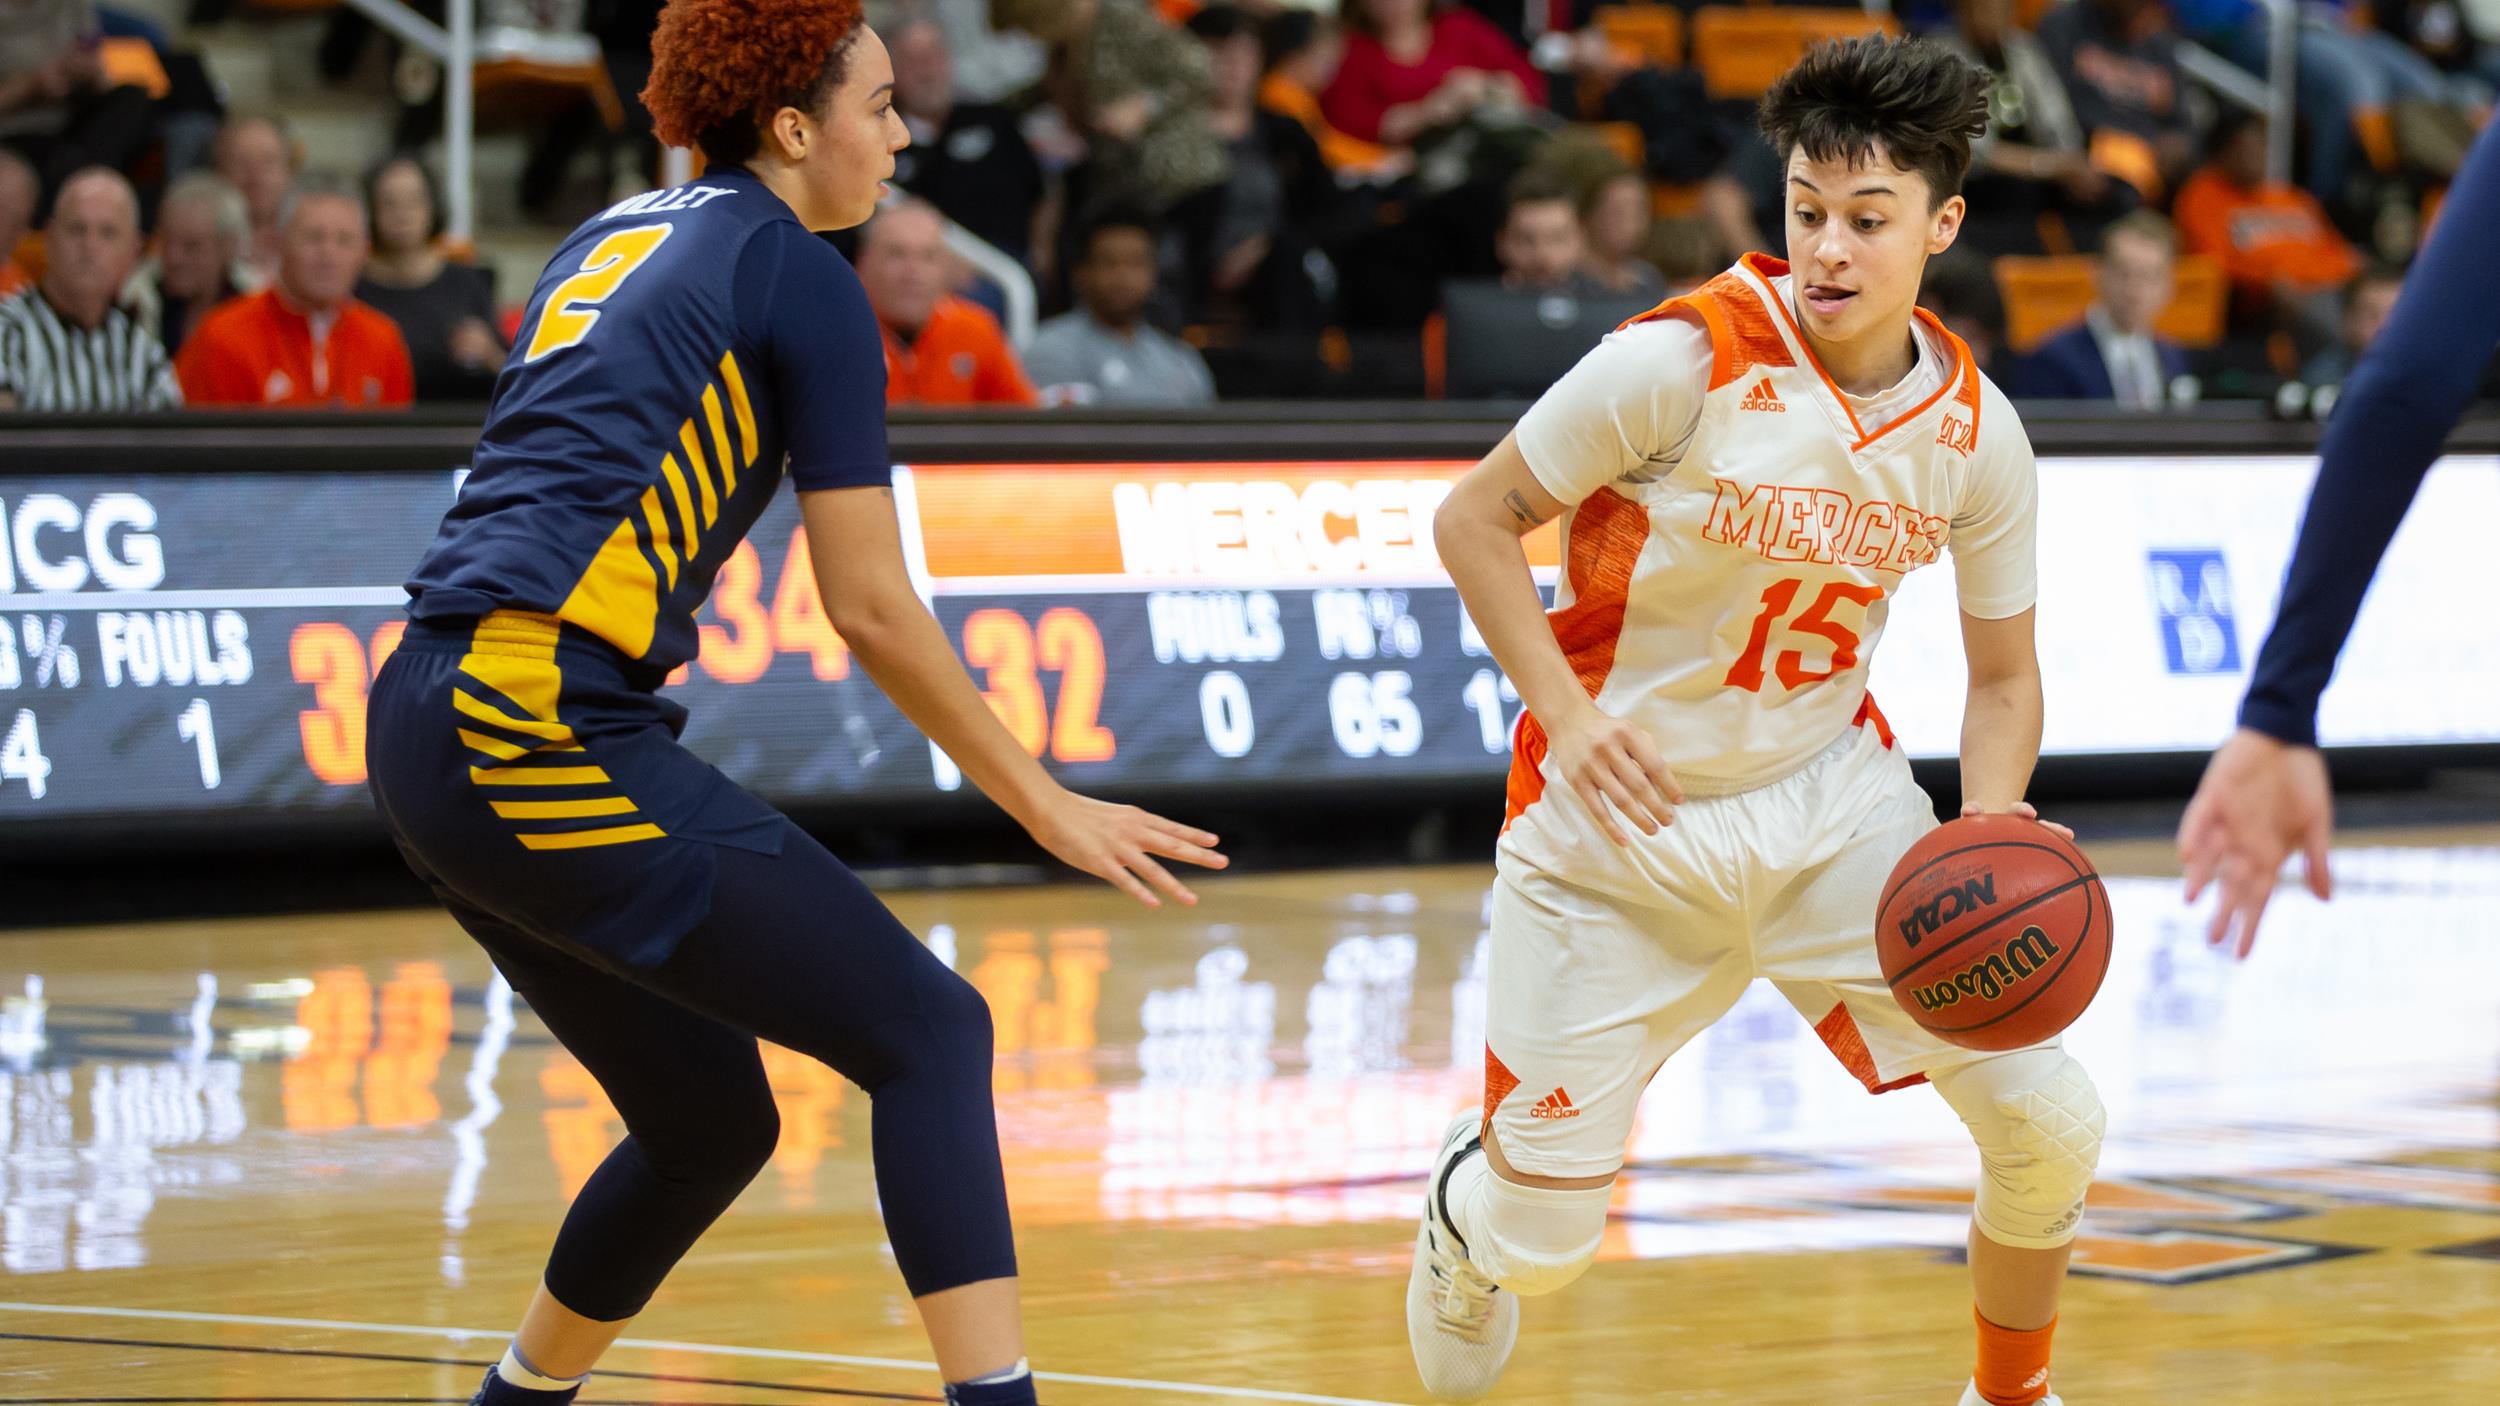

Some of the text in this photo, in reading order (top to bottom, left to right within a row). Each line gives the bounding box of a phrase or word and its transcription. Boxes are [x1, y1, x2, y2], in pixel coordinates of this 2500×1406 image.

[524, 222, 674, 364] 2
[1739, 399, 1786, 413] adidas
[0, 493, 165, 592] CG
[97, 610, 254, 688] FOULS
[664, 525, 850, 686] 34
[1722, 578, 1885, 693] 15
[289, 621, 408, 786] 3
[962, 606, 1116, 763] 32
[1199, 670, 1255, 758] 0
[1328, 670, 1423, 758] 65
[0, 697, 221, 800] 4 1
[1898, 872, 1997, 949] NCAA
[1911, 924, 2061, 1013] Wilson
[1530, 1106, 1580, 1119] adidas
